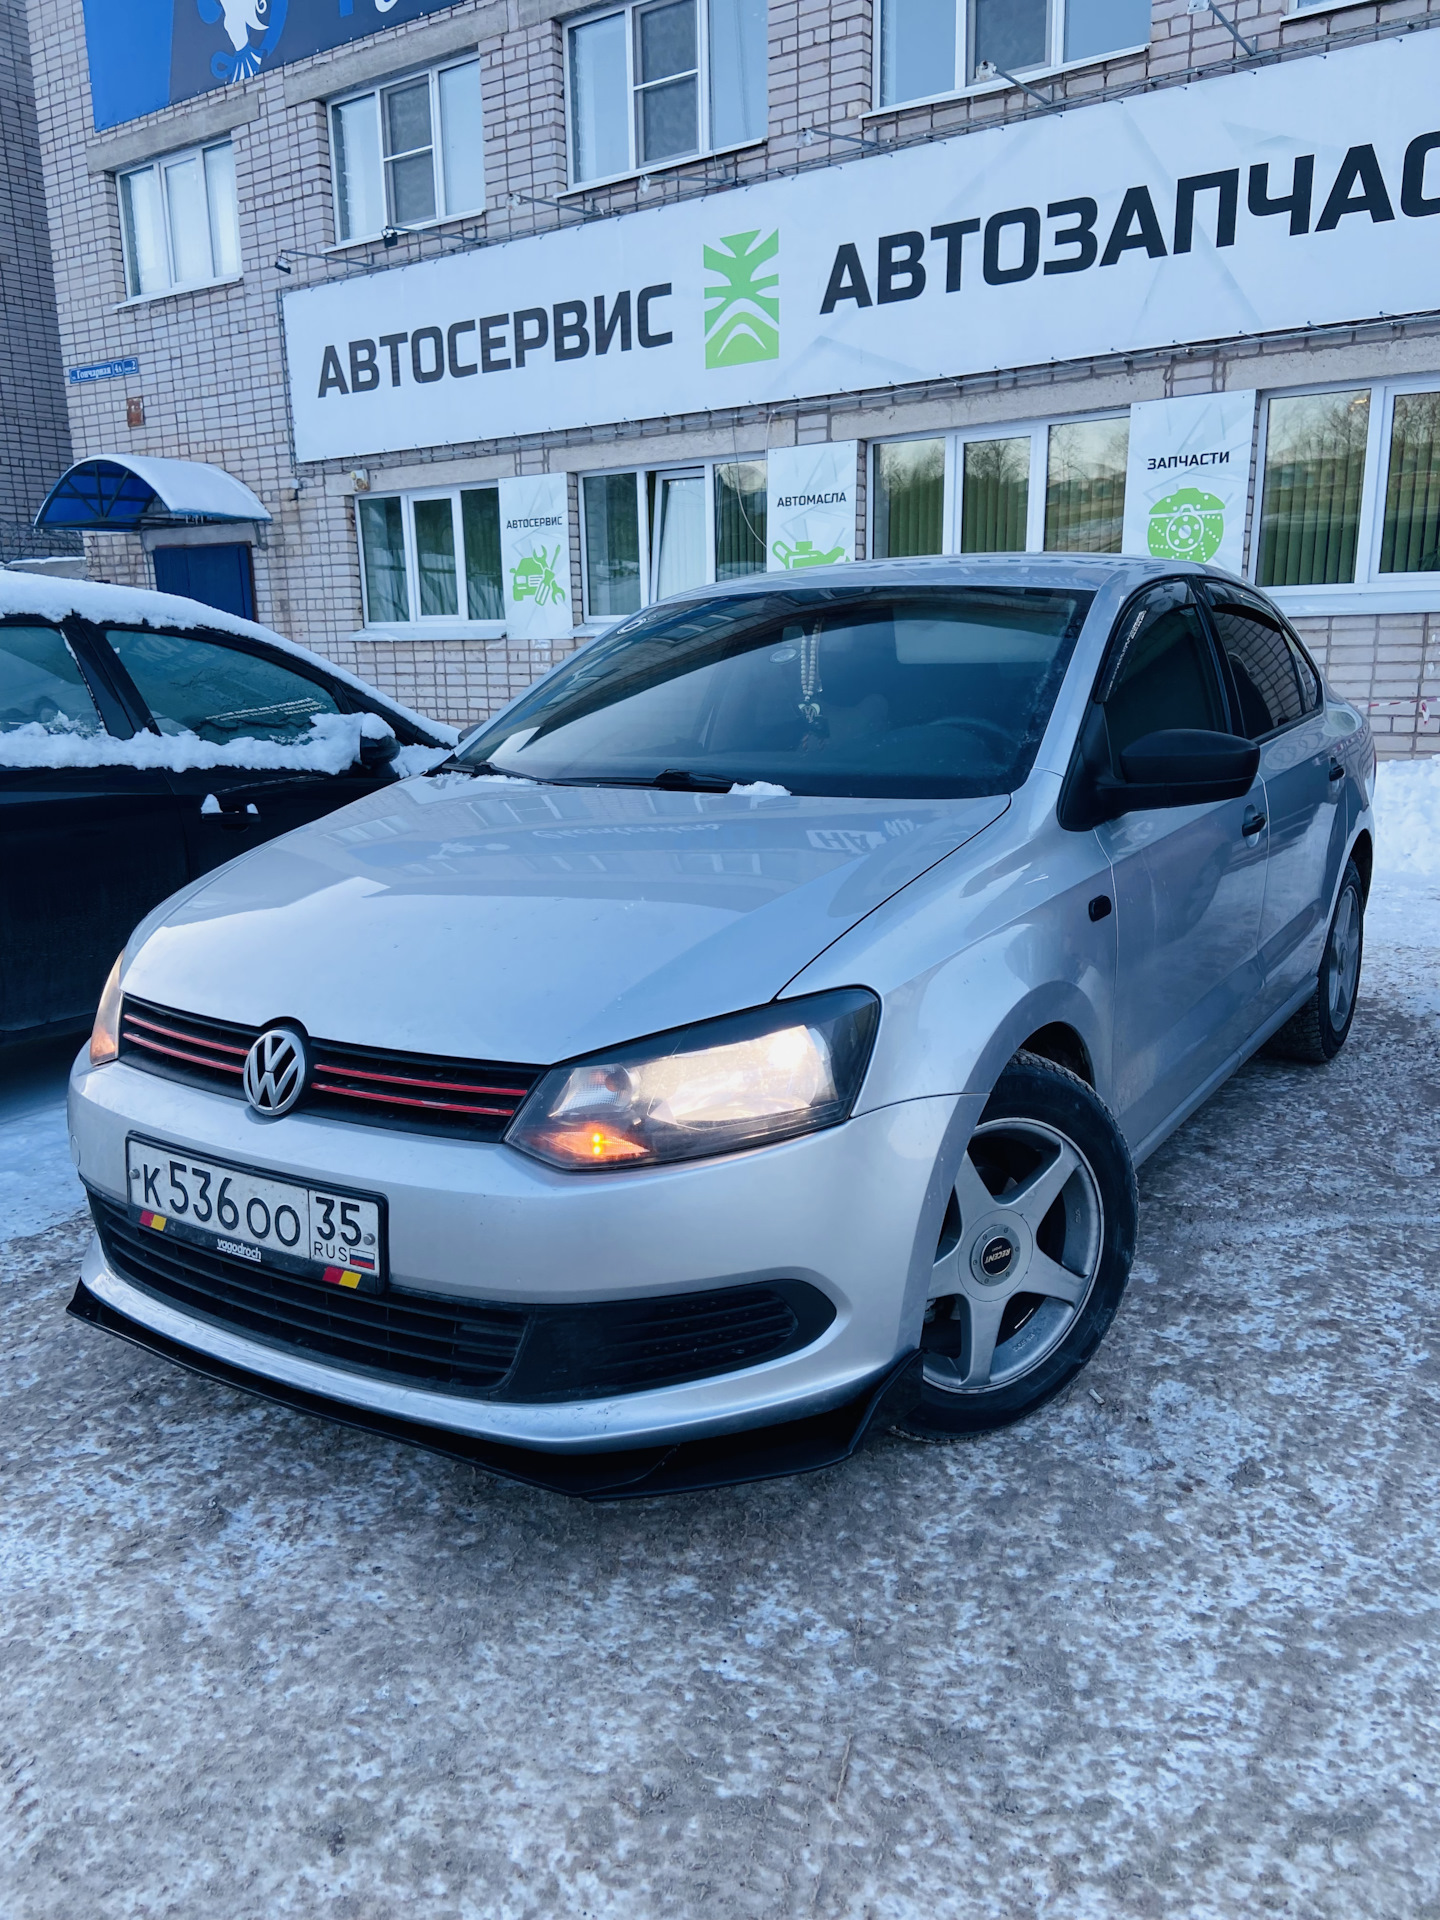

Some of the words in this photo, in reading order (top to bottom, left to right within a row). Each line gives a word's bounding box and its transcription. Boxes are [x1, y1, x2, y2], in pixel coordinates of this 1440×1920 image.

[318, 282, 673, 398] АВТОСЕРВИС
[1147, 451, 1230, 470] ЗАПЧАСТИ
[777, 491, 847, 507] АВТОМАСЛА
[506, 516, 563, 529] АВТОСЕРВИС
[315, 1196, 362, 1247] 35
[314, 1241, 348, 1262] RUS
[984, 1248, 1011, 1264] RECENT
